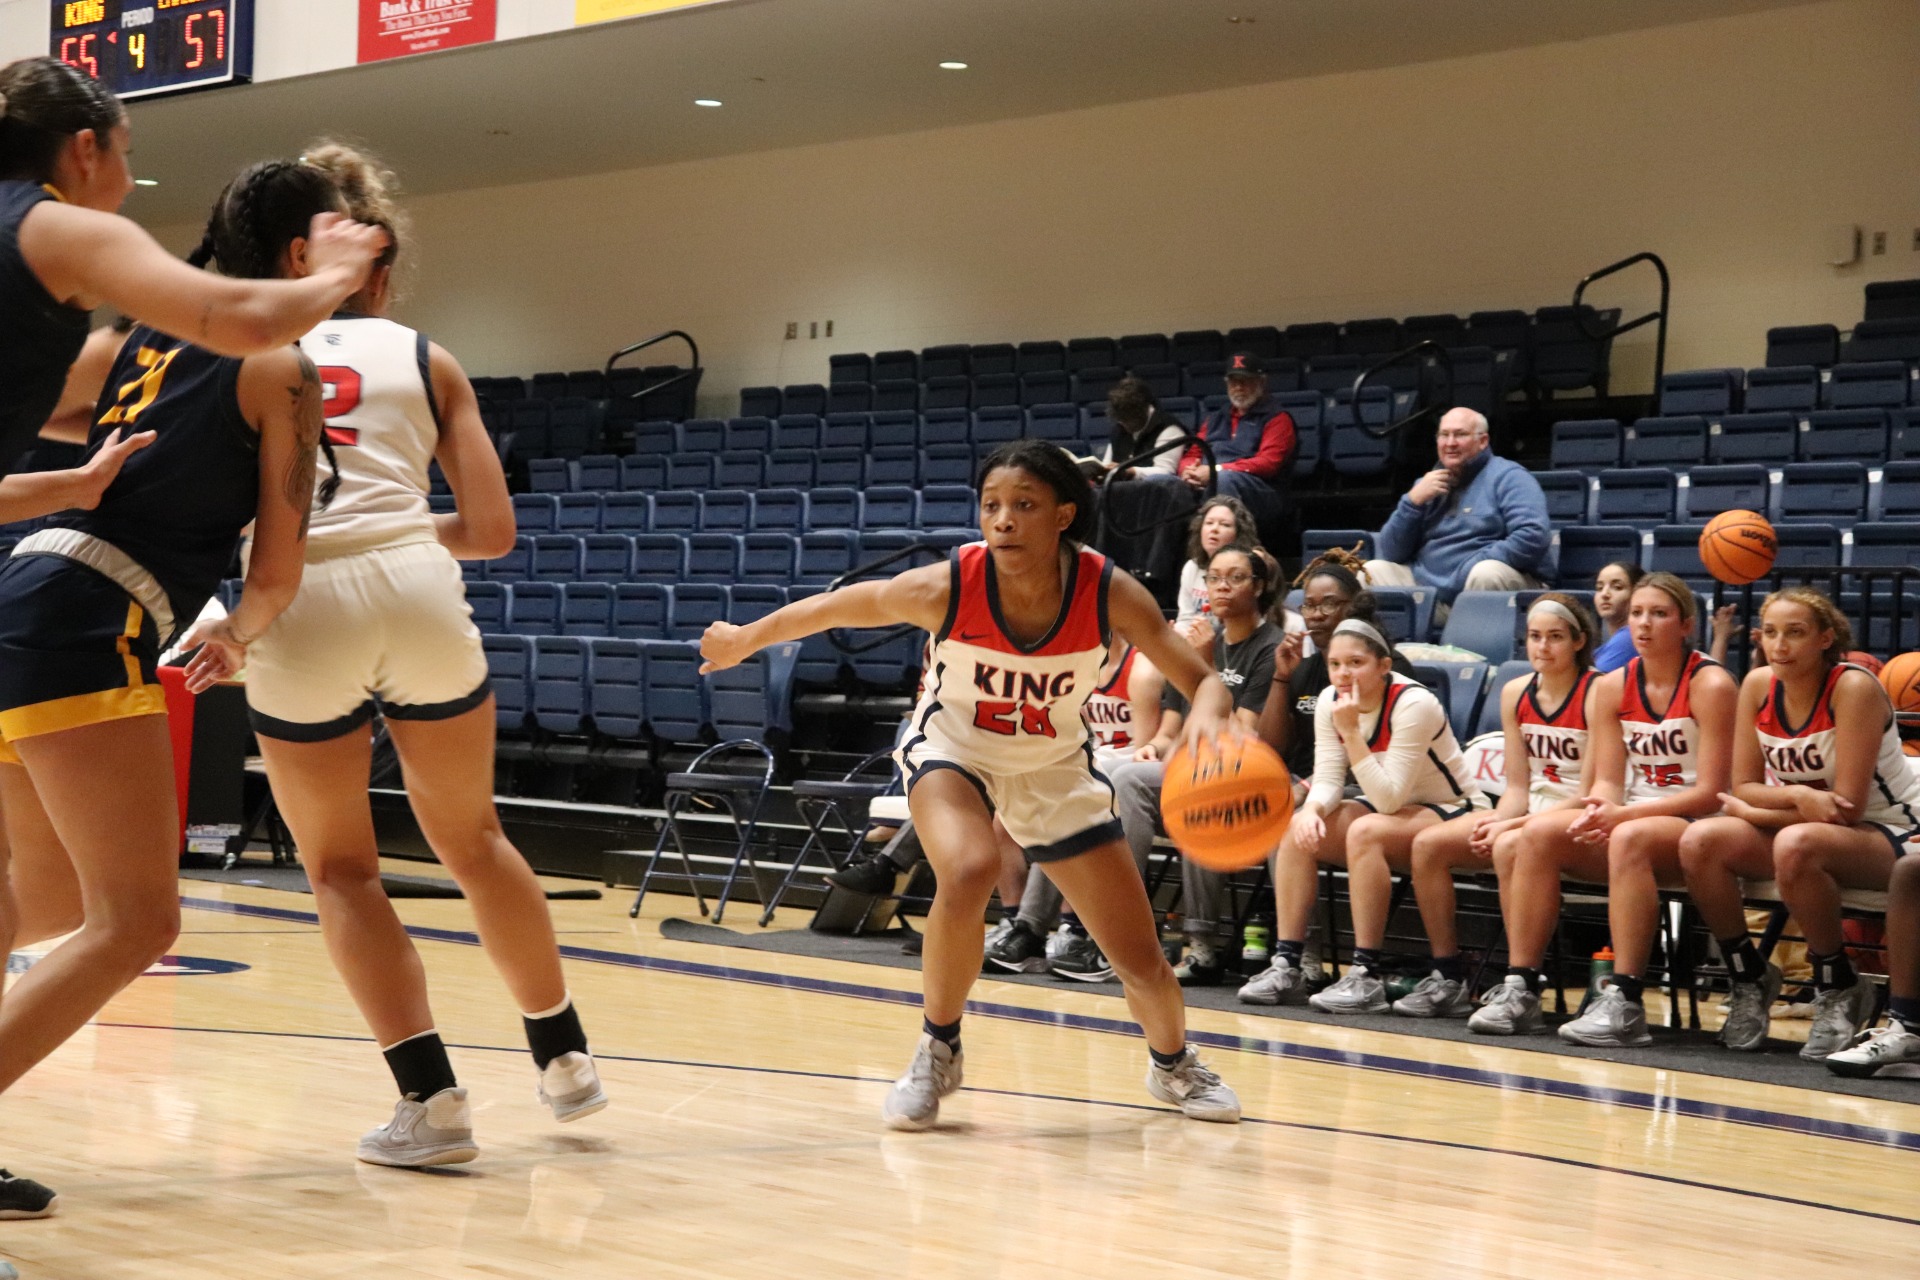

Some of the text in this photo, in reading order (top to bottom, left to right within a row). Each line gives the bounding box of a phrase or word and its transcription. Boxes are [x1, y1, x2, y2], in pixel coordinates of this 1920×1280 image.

[64, 0, 105, 28] KING
[121, 7, 155, 28] PERIOD
[380, 0, 408, 18] Bank
[129, 34, 145, 69] 4
[185, 10, 224, 69] 57
[1232, 355, 1246, 369] K
[974, 661, 1075, 702] KING
[1086, 702, 1131, 724] KING
[1525, 733, 1580, 760] KING
[1629, 729, 1689, 756] KING
[1763, 743, 1825, 773] KING
